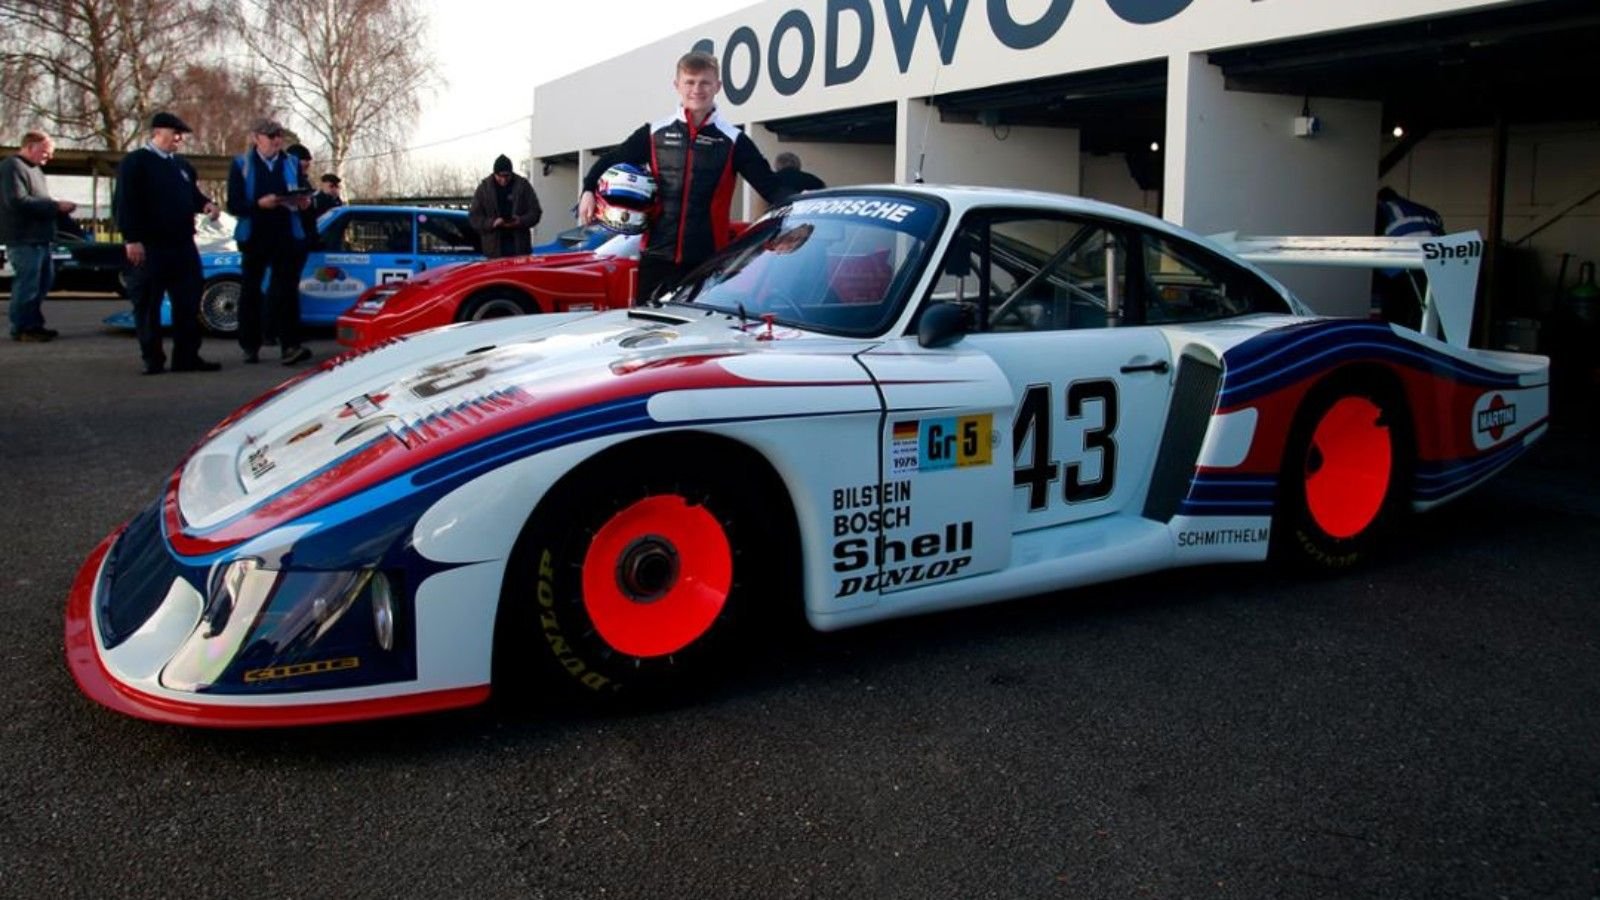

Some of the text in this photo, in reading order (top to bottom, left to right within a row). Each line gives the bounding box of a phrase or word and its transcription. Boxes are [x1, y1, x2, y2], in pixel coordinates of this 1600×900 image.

[1422, 241, 1480, 259] Shell
[928, 421, 977, 461] Gr 5
[1012, 379, 1120, 513] 43
[833, 480, 911, 511] BILSTEIN
[833, 505, 910, 537] BOSCH
[1177, 527, 1268, 548] SCHMITTHELM
[833, 521, 973, 572] Shell
[835, 555, 972, 599] DUNLOP
[537, 549, 609, 691] DUNLOP
